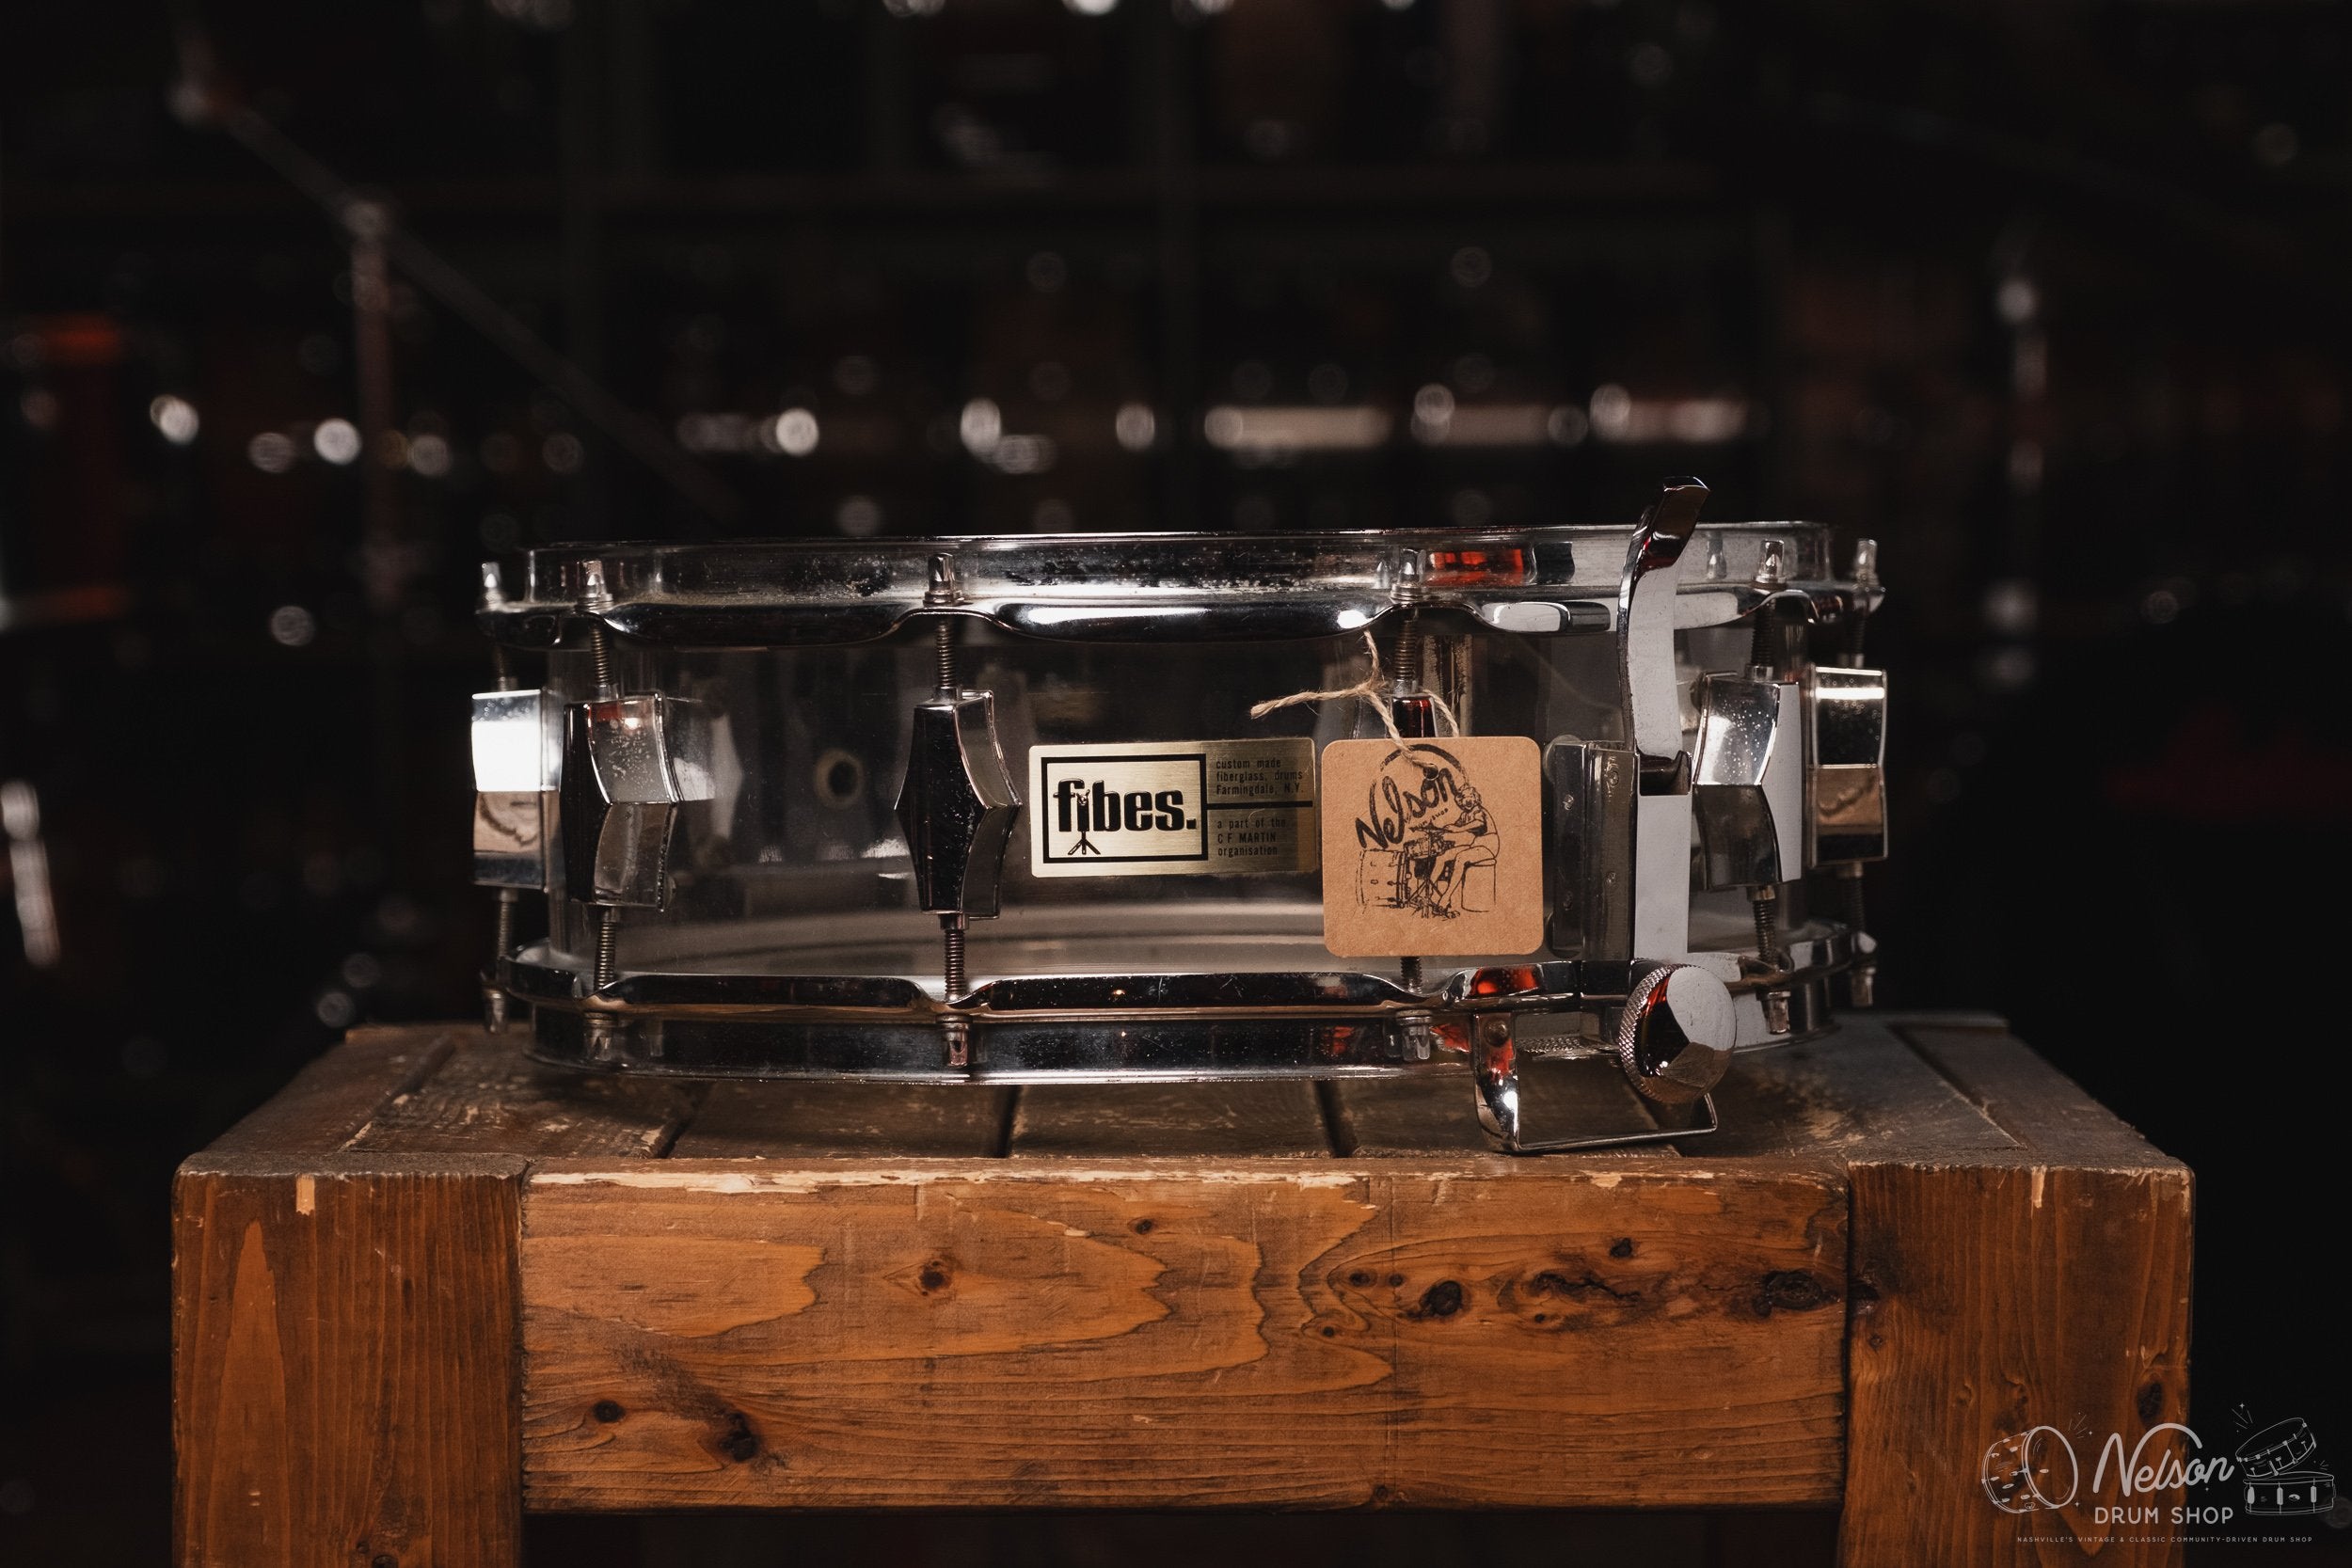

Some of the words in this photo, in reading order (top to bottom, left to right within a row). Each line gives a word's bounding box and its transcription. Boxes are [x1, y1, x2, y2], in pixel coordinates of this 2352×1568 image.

[1216, 760, 1250, 769] custom
[1257, 758, 1281, 768] made
[1275, 769, 1303, 781] drums
[1216, 784, 1278, 797] Farmingdale,
[1284, 783, 1304, 793] N.Y.
[1356, 744, 1466, 848] Nelson
[1054, 778, 1197, 832] fibes.
[1217, 820, 1222, 829] a
[1229, 819, 1248, 831] part
[1255, 817, 1264, 828] of
[1271, 817, 1286, 828] the
[1217, 833, 1223, 844] C
[1228, 832, 1232, 843] F
[1239, 832, 1276, 843] MARTIN
[1217, 847, 1278, 857] organisation
